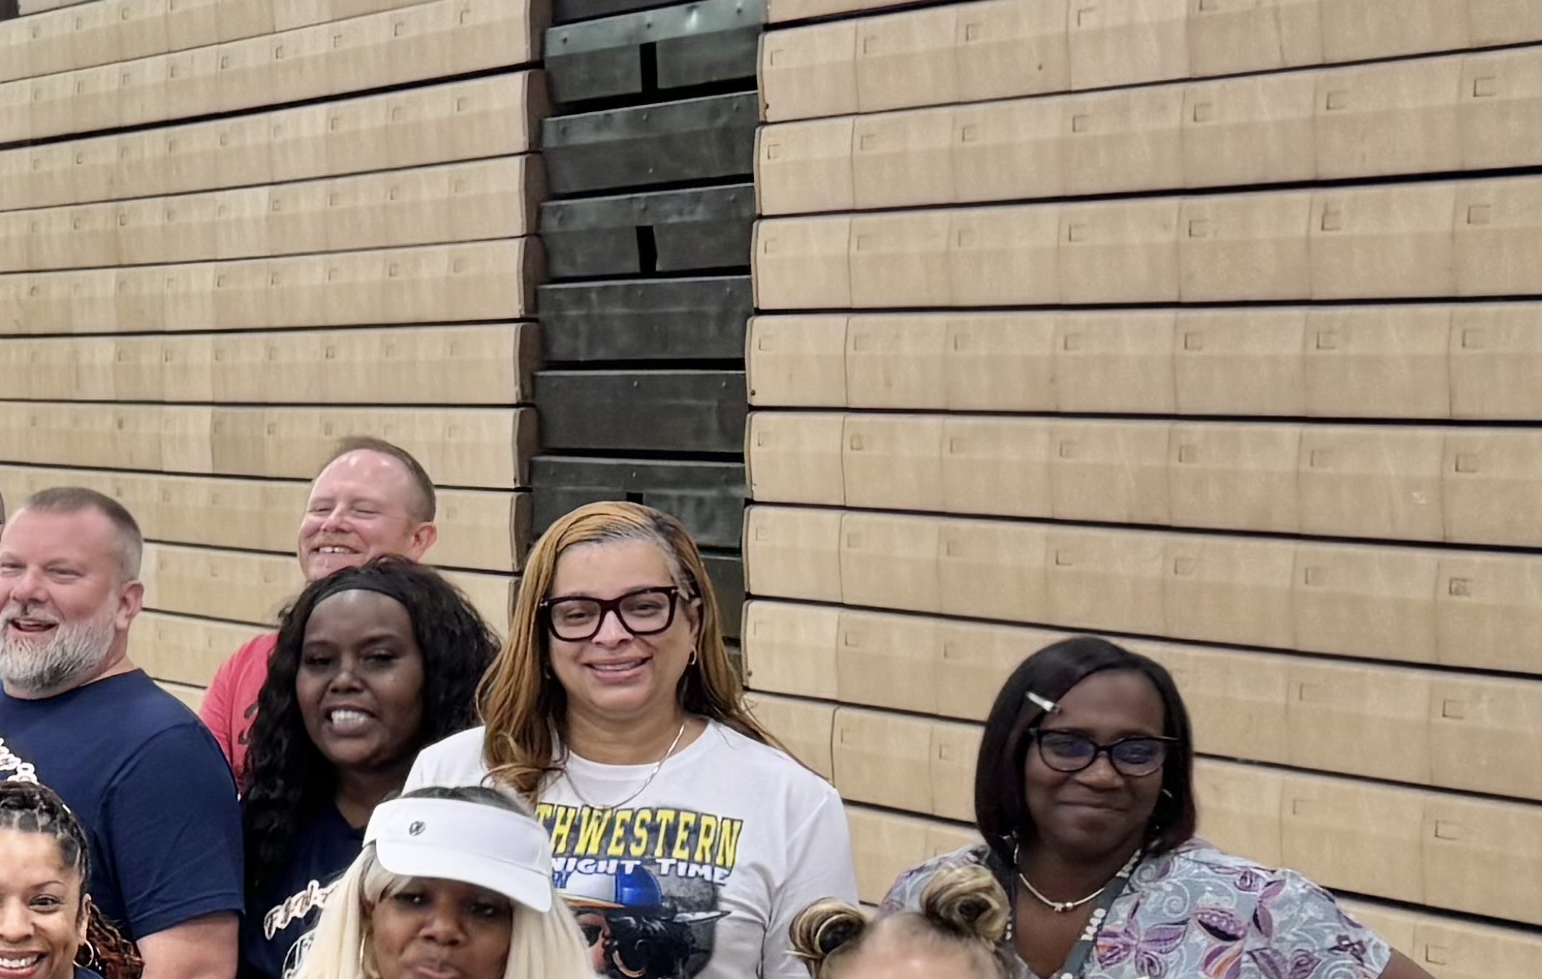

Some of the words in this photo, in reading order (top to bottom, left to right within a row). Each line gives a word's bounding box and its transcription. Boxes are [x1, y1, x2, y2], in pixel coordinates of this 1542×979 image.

[535, 802, 744, 872] THWESTERN
[551, 856, 642, 876] NIGHT
[654, 858, 733, 884] TIME
